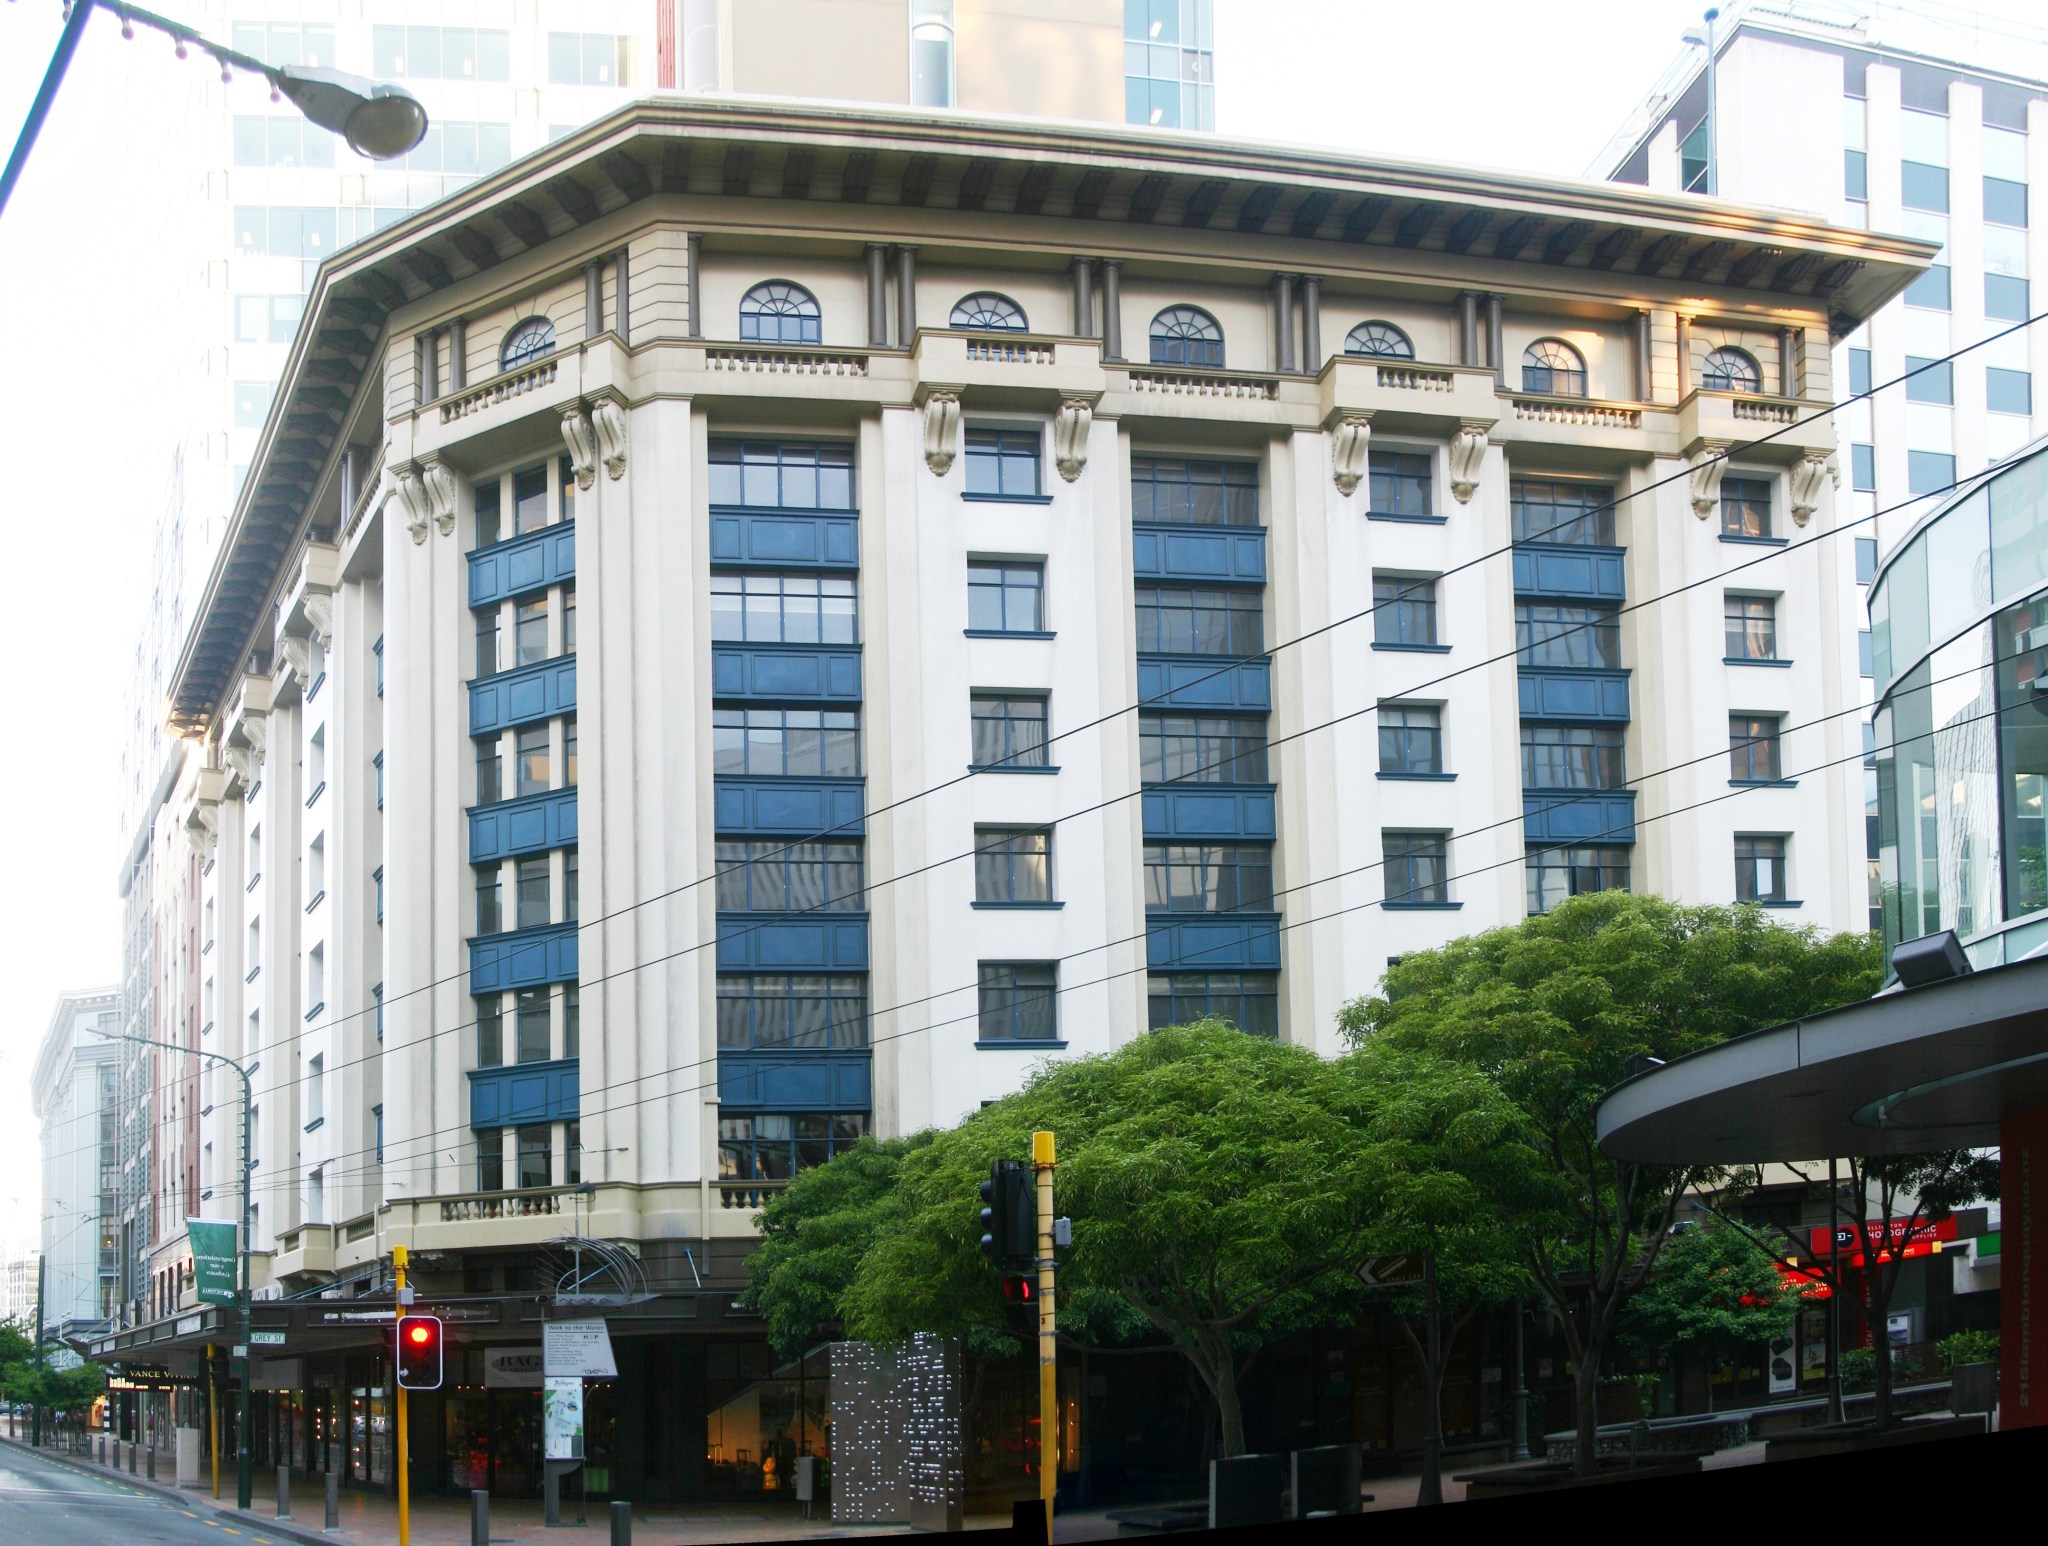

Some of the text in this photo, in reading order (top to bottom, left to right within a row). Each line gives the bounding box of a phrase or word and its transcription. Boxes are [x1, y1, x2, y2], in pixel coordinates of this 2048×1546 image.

[1868, 1225, 1937, 1239] HOOGRPIC
[2019, 1147, 2031, 1408] 215lambtonquay.co.nz
[1041, 1317, 1045, 1325] 3
[254, 1334, 281, 1342] GREY ST
[129, 1370, 160, 1379] VANCE
